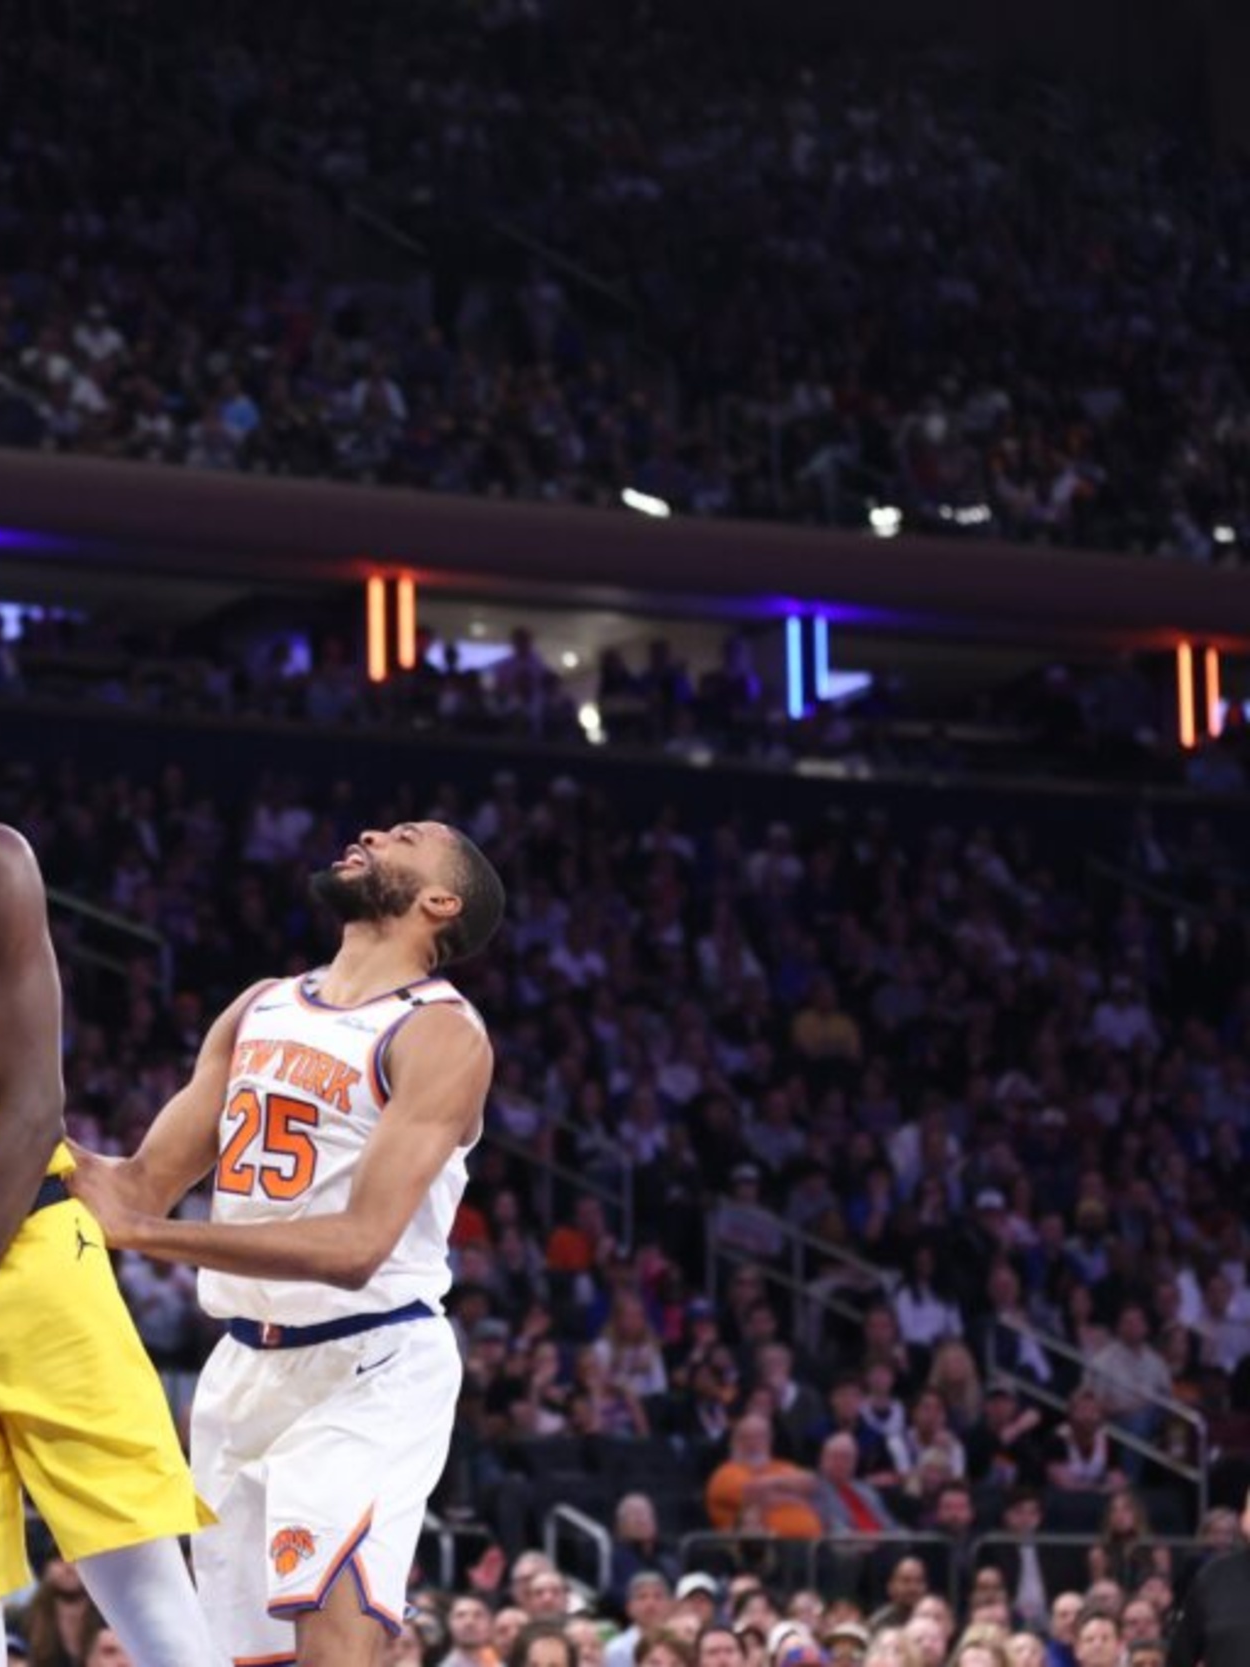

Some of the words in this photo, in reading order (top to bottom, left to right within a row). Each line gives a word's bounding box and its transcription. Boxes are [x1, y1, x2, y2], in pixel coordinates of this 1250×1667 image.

[232, 1039, 277, 1077] EW
[274, 1040, 362, 1114] YORK
[216, 1088, 319, 1201] 25
